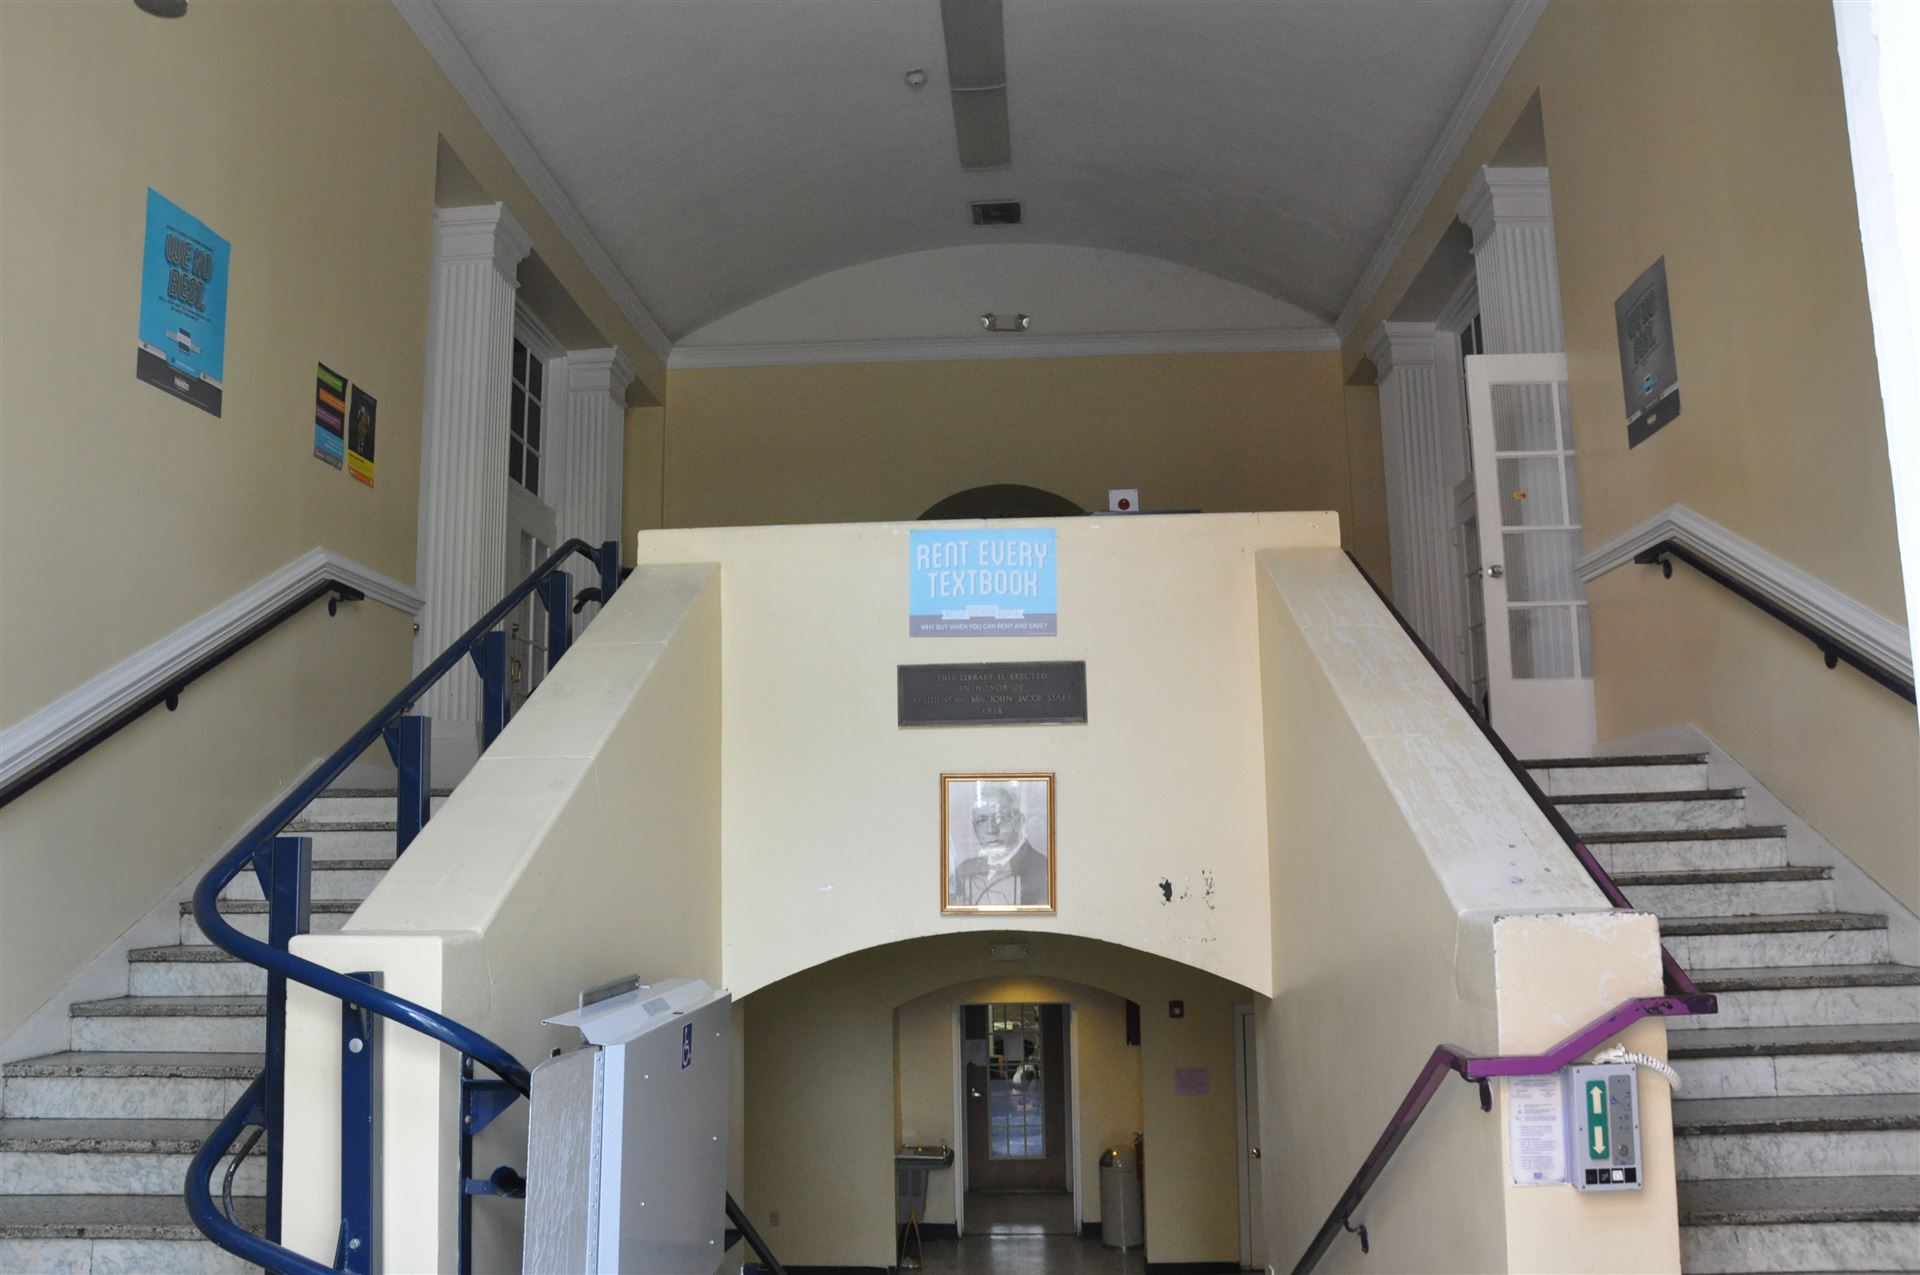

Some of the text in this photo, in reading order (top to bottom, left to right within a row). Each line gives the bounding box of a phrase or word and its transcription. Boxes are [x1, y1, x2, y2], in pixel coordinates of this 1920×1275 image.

[165, 233, 192, 269] WE
[917, 540, 1048, 571] RENT EVERY
[928, 569, 1039, 599] TEXTBOOK
[997, 622, 1013, 630] RENT
[937, 674, 957, 682] THIS
[960, 673, 992, 681] LIBRARY
[1010, 672, 1047, 680] ERECTED
[960, 683, 1023, 693] IN HONOR OF
[990, 695, 1013, 703] JOHN
